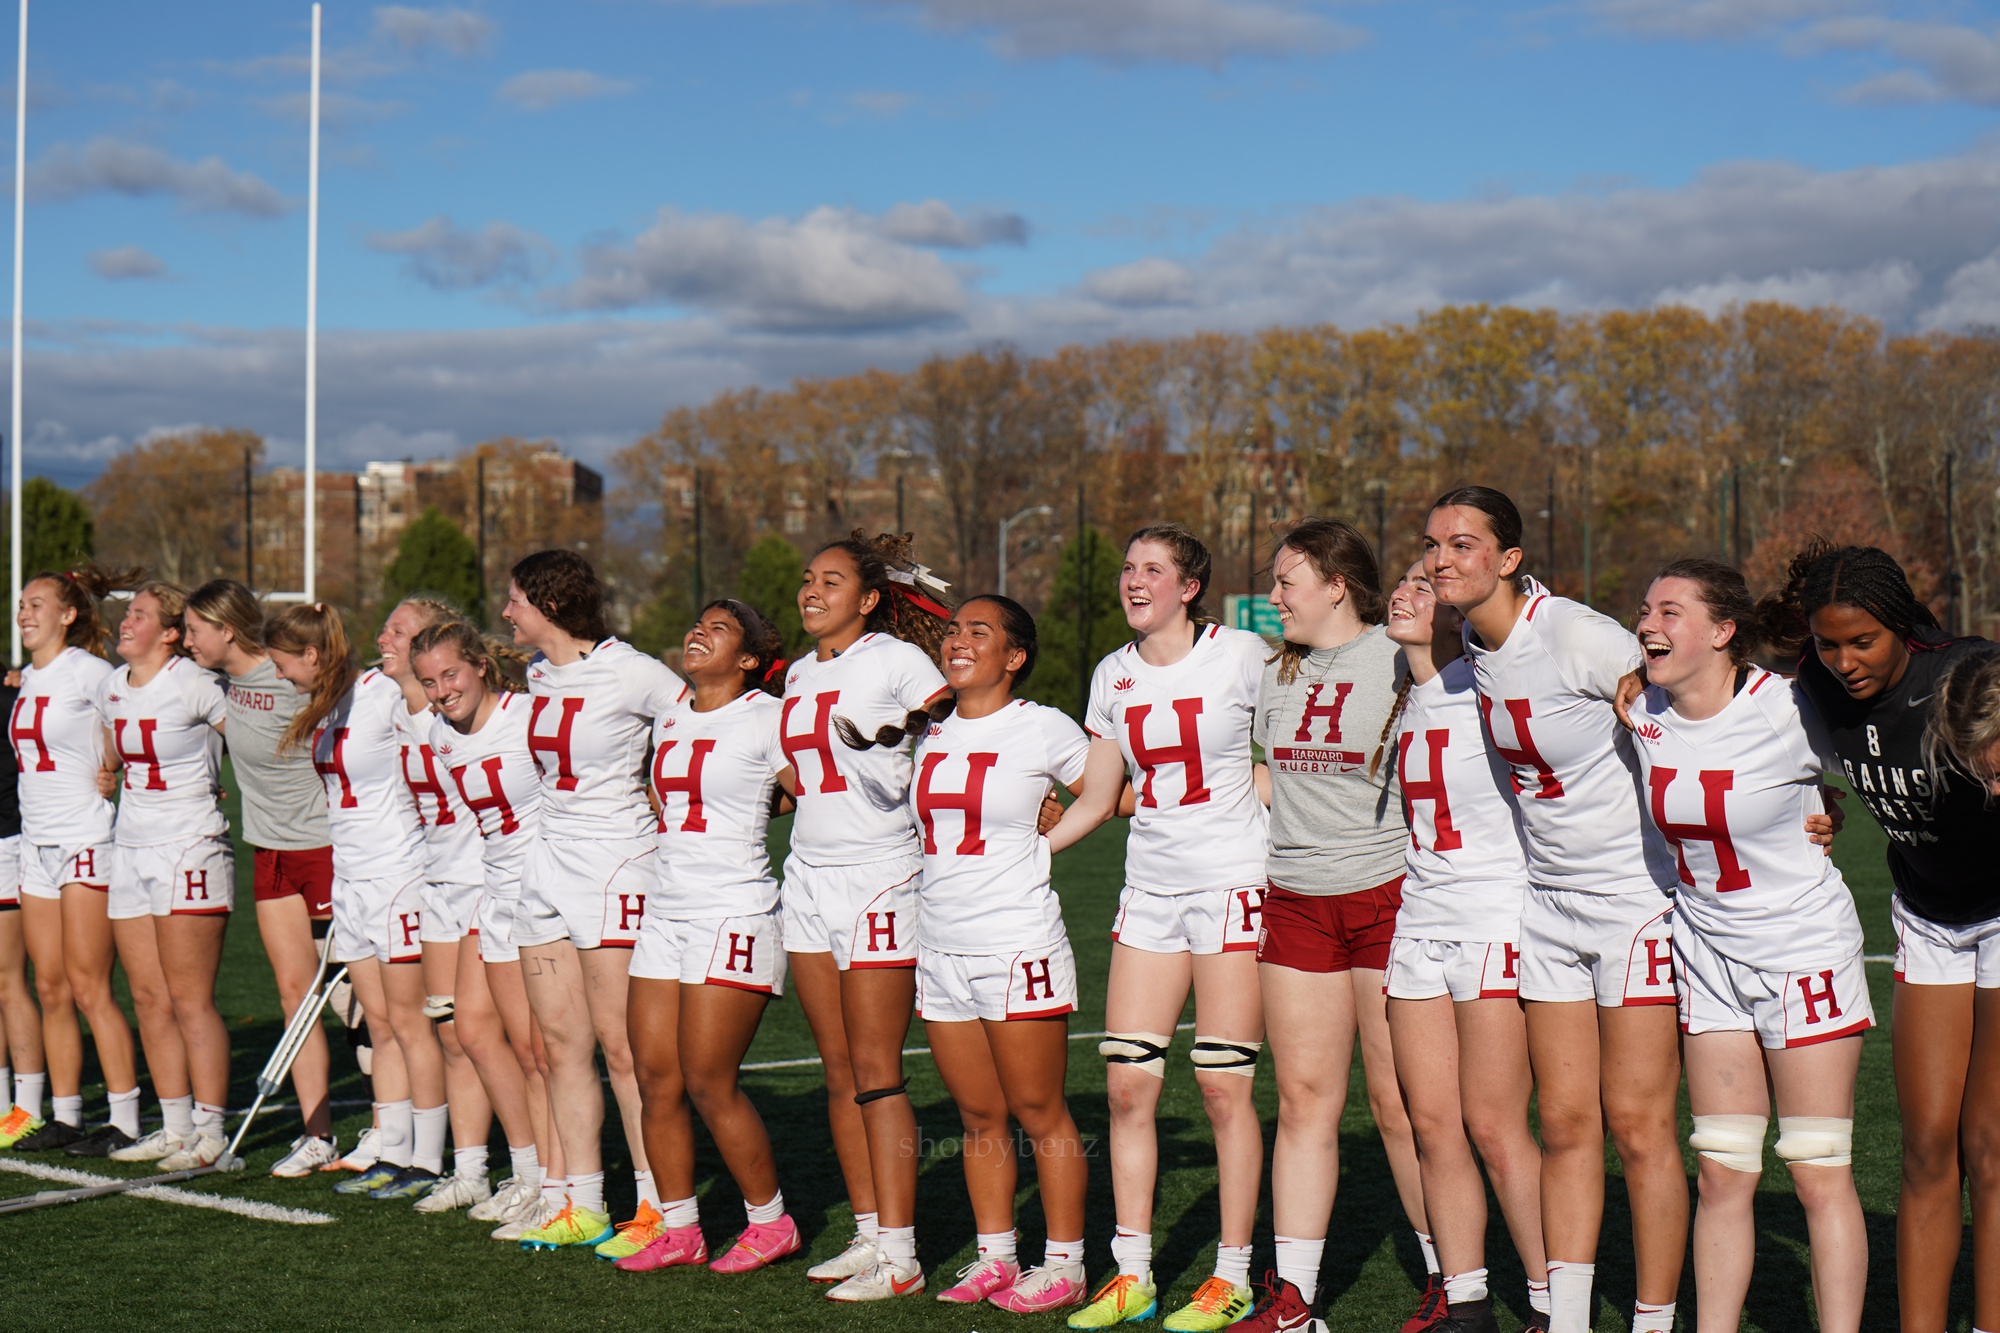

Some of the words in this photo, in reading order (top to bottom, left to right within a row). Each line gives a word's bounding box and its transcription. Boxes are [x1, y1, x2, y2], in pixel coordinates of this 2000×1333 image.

[11, 695, 56, 773] H
[528, 696, 585, 791] H
[780, 690, 848, 797] H
[1294, 682, 1354, 744] H
[1480, 690, 1565, 800] H
[1866, 724, 1881, 757] 8
[114, 718, 167, 790] H
[312, 727, 358, 809] H
[400, 744, 456, 827] H
[653, 739, 716, 833] H
[1124, 697, 1211, 809] H
[1279, 762, 1329, 773] RUGBY
[1291, 749, 1344, 762] HARVARD
[1835, 751, 1951, 798] GAINST
[450, 756, 520, 836] H
[916, 752, 999, 856] H
[1398, 728, 1463, 852] H
[1648, 765, 1752, 893] H
[74, 849, 95, 878] H
[185, 870, 208, 900] H
[619, 894, 645, 930] H
[866, 911, 898, 952] H
[725, 932, 755, 974] H
[1022, 958, 1054, 1001] H
[1645, 937, 1676, 986] H
[1797, 969, 1843, 1025] H
